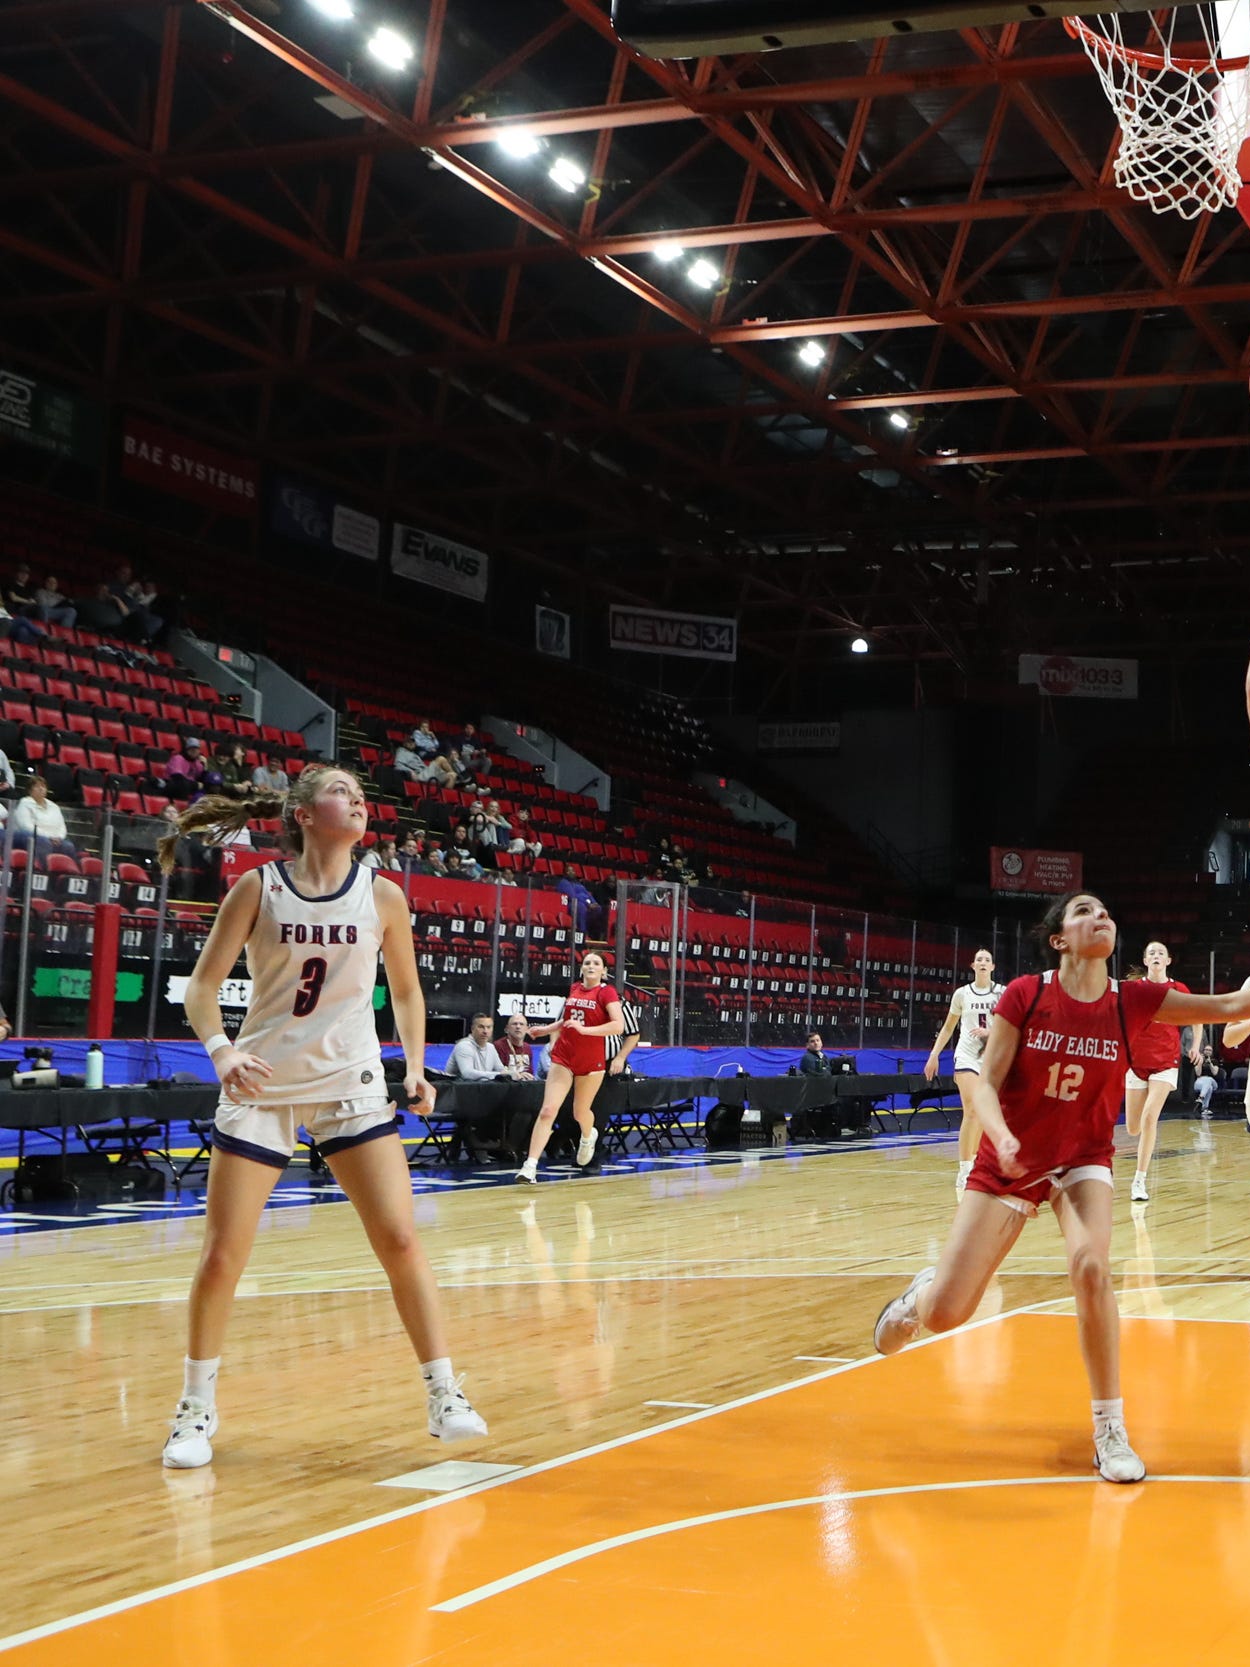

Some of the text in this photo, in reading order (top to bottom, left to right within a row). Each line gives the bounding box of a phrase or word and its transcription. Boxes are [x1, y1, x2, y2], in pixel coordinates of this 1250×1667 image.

[123, 435, 256, 499] BAE SYSTEMS
[403, 528, 480, 578] EVANS
[614, 614, 732, 651] NEWS 34
[279, 923, 358, 947] FORKS
[57, 975, 92, 996] Cra
[292, 957, 328, 1018] 3
[511, 998, 551, 1014] Craft
[570, 1009, 585, 1026] 22
[1026, 1028, 1119, 1062] LADY EAGLES
[1044, 1062, 1085, 1102] 12
